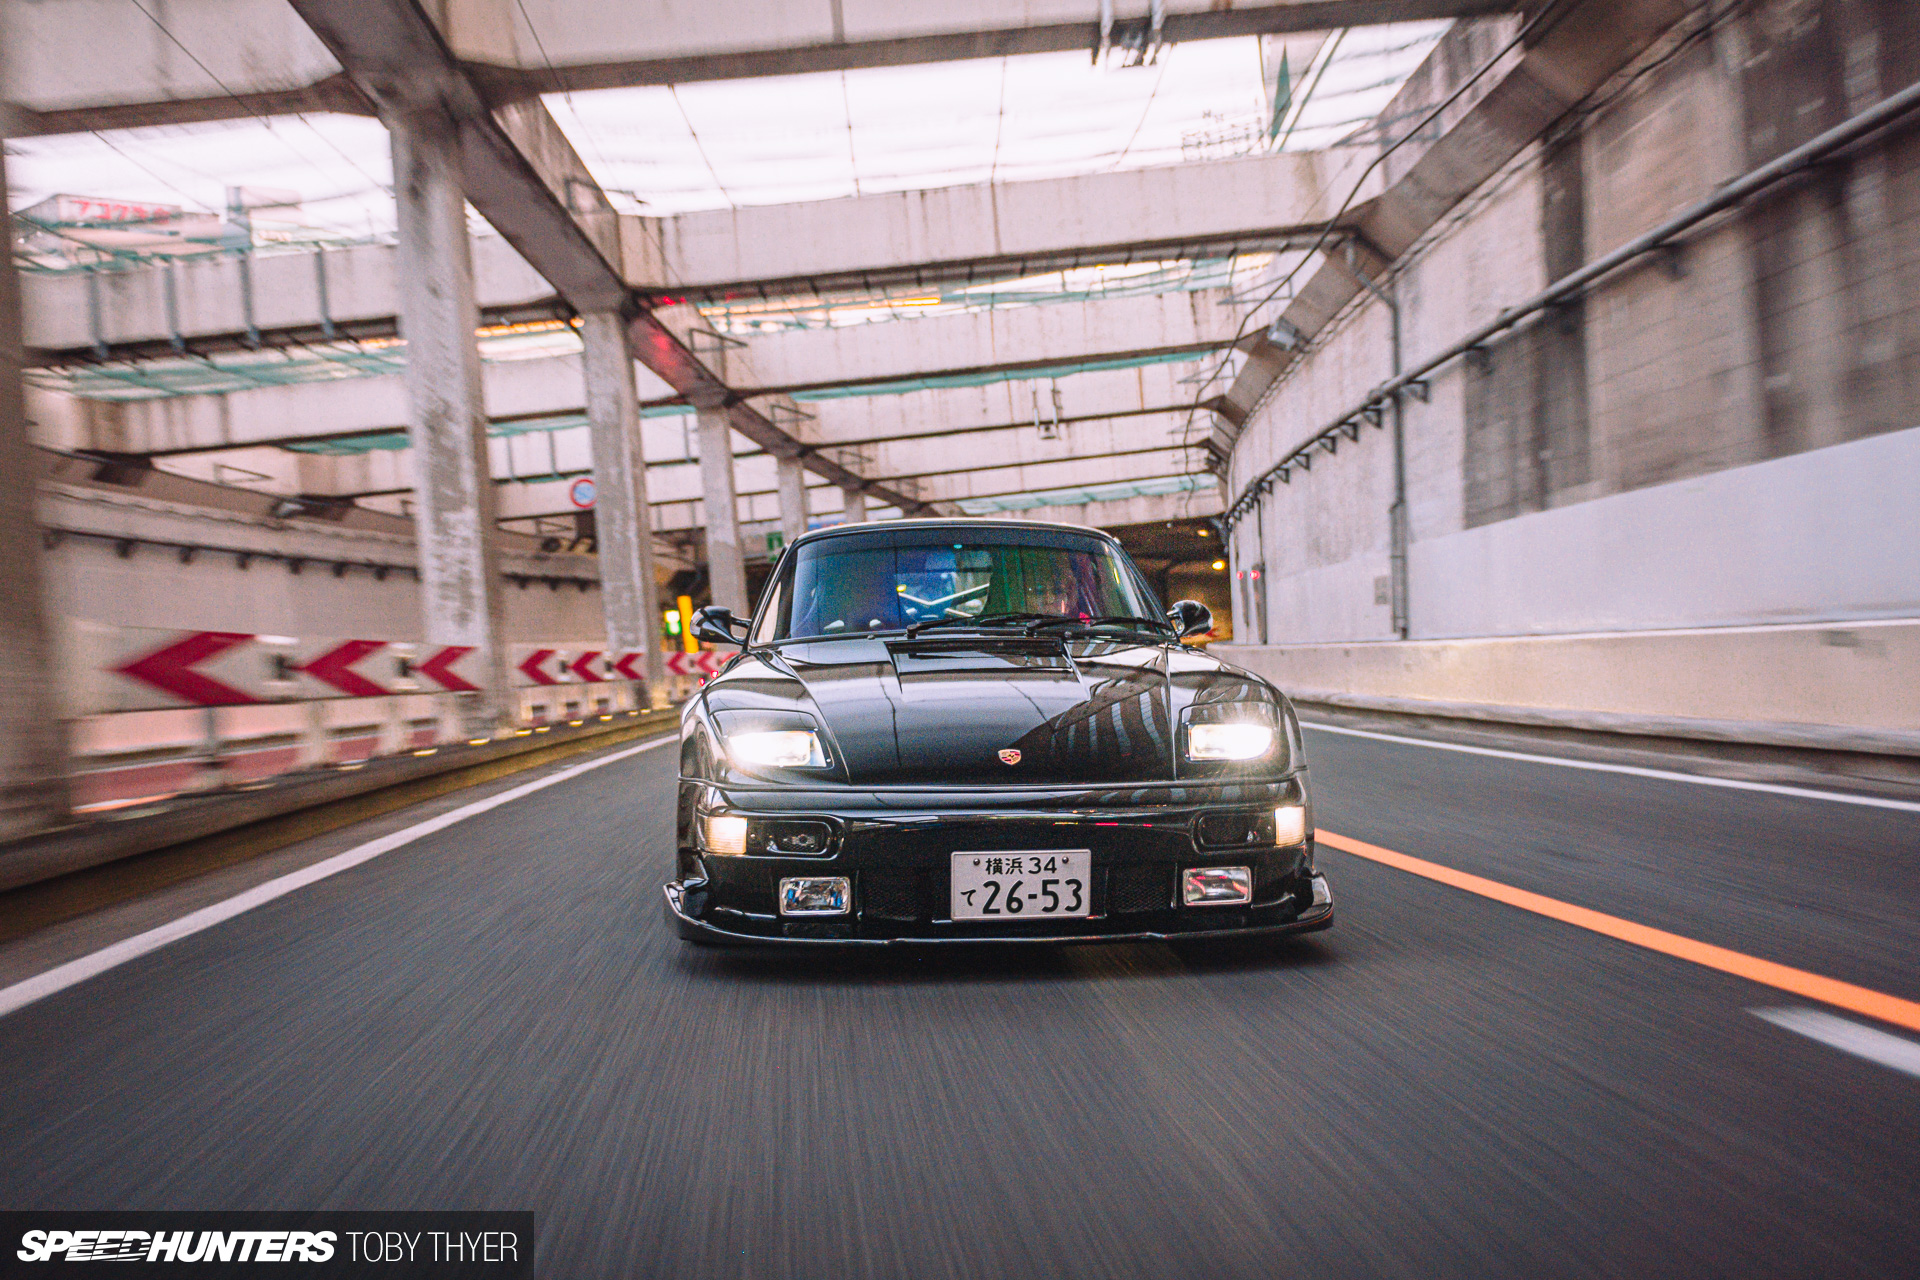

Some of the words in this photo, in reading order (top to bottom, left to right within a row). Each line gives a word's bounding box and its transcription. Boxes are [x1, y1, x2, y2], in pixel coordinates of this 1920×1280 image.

[985, 857, 1023, 875] 横浜
[1028, 856, 1057, 875] 34
[960, 889, 977, 907] て
[982, 878, 1083, 915] 26-53
